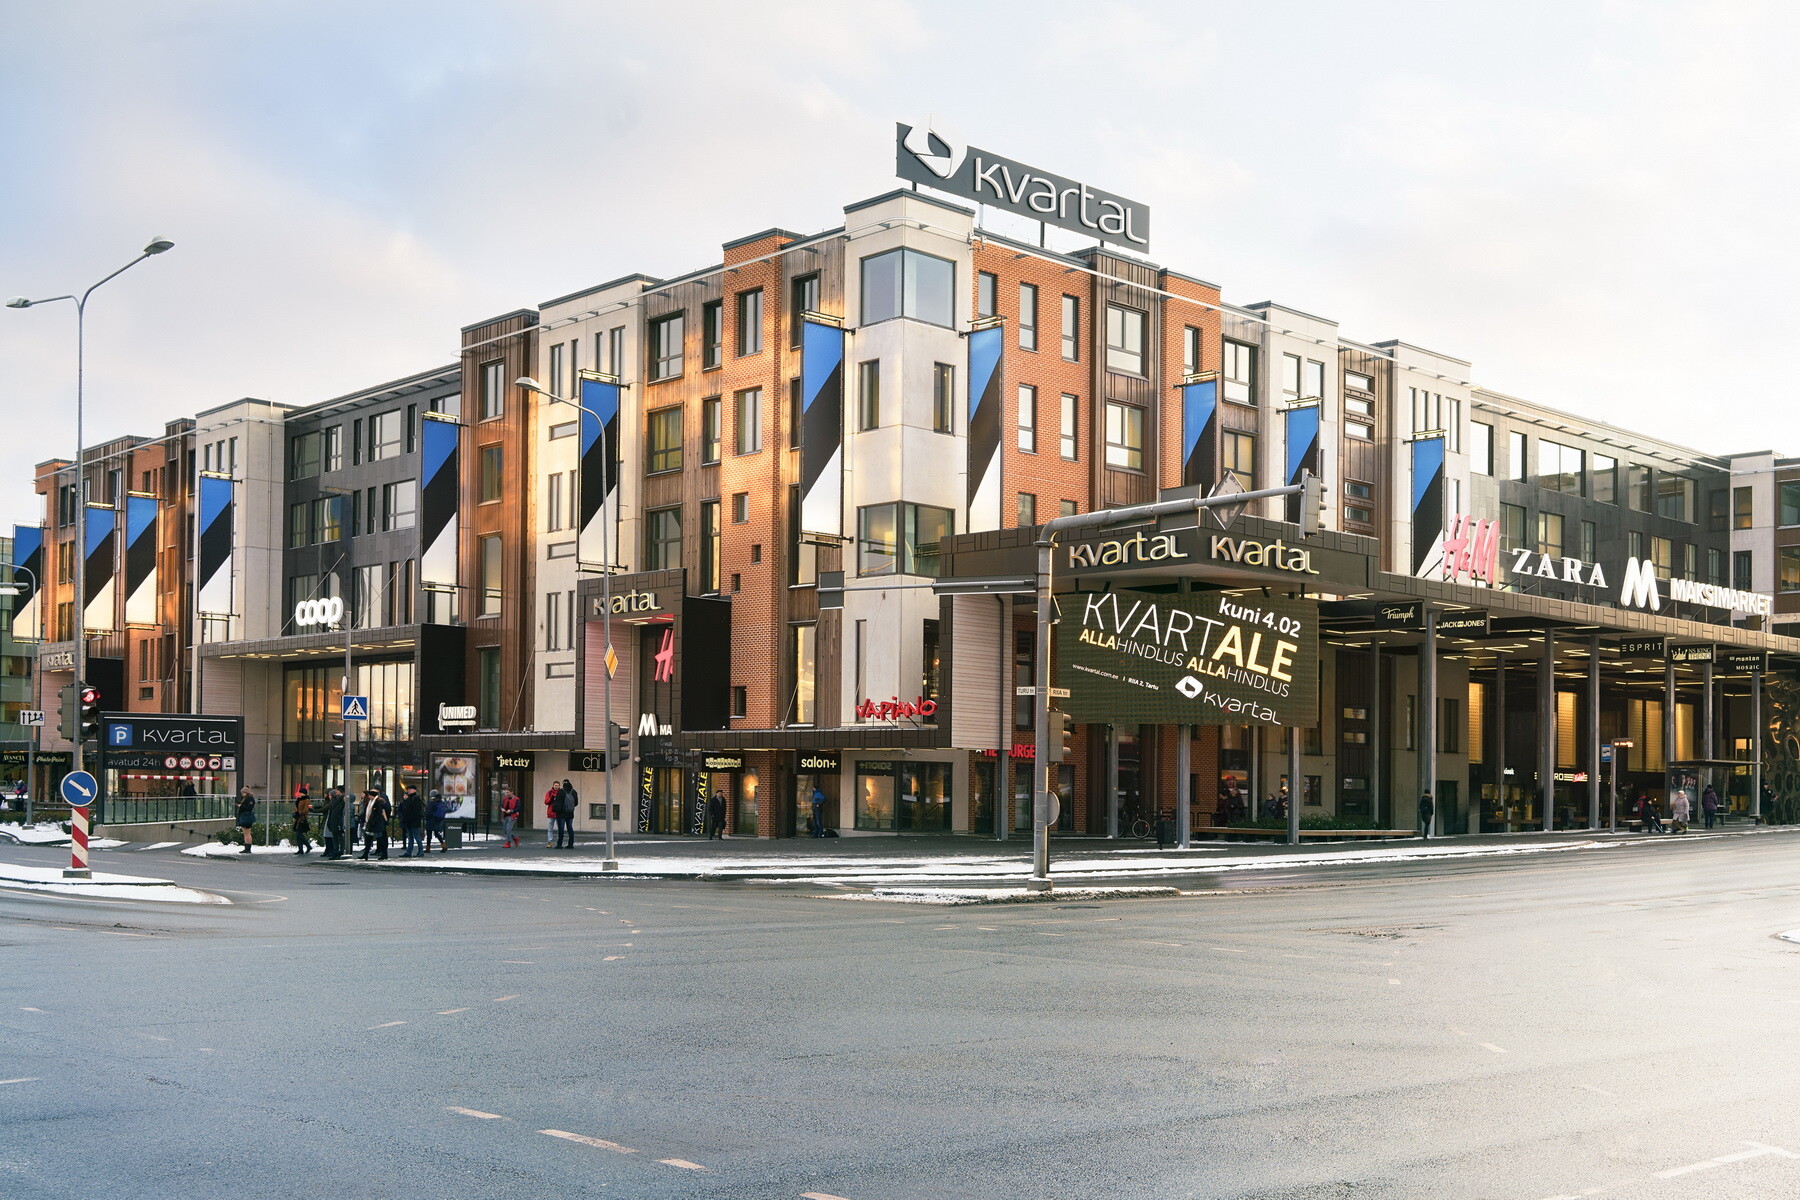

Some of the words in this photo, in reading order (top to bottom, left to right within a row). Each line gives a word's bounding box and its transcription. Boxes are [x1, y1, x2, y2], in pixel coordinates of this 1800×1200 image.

[1442, 513, 1499, 584] H&M
[1511, 548, 1609, 588] ZARA
[1381, 606, 1415, 623] Triumph
[1670, 577, 1773, 616] MAKSIMARKET
[1083, 592, 1298, 683] KVARTALE
[1219, 597, 1261, 625] kuni
[1262, 612, 1301, 639] 4.02
[1079, 628, 1185, 667] ALLAHINDLUS
[1622, 643, 1663, 652] ESPRIT
[1186, 656, 1290, 698] ALLAHINDLUS
[855, 696, 938, 721] VAPIANO
[107, 758, 140, 767] avatud
[142, 758, 161, 767] 24h
[800, 755, 837, 768] salon+
